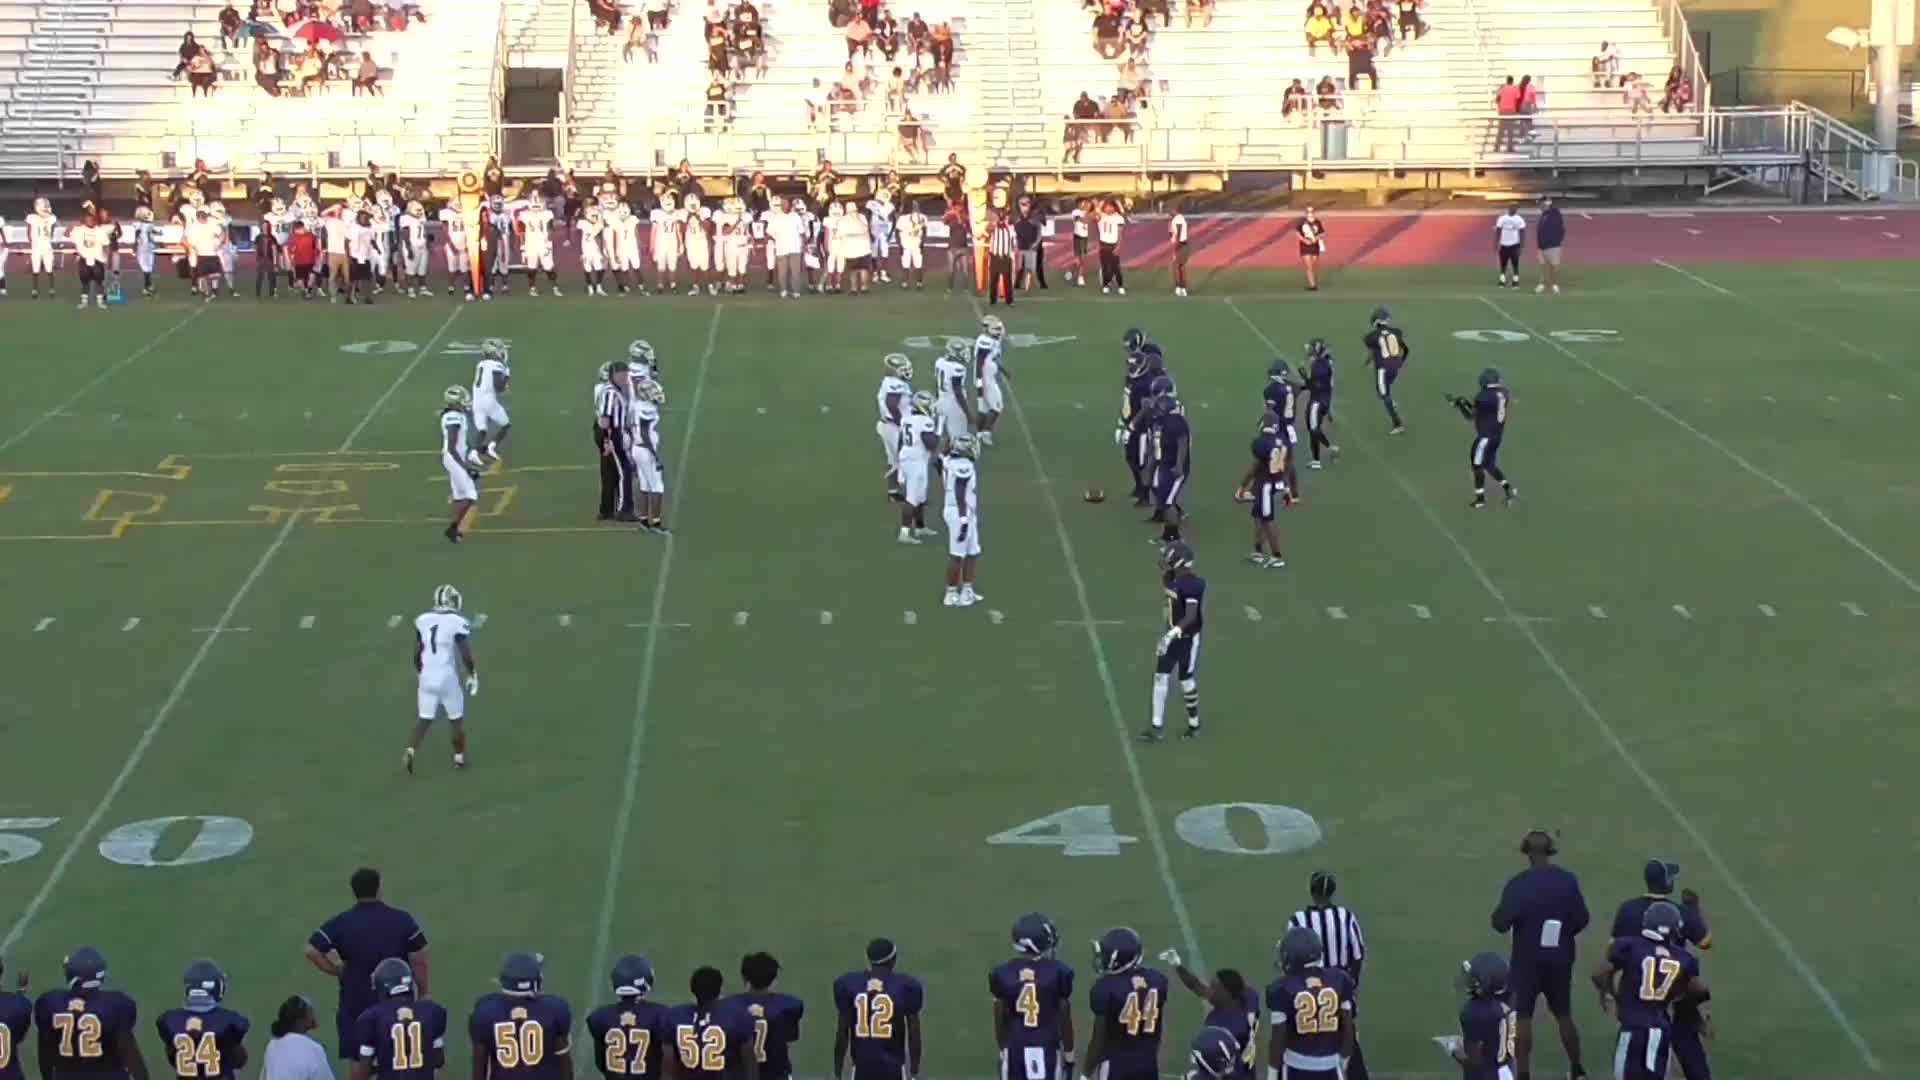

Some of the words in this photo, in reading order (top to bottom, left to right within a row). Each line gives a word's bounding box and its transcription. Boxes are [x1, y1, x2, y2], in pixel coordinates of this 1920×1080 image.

[1379, 333, 1400, 359] 10
[430, 624, 438, 655] 1
[987, 803, 1322, 856] 40
[1639, 956, 1681, 1000] 17
[855, 993, 894, 1039] 12
[1016, 981, 1040, 1028] 4
[1119, 988, 1159, 1036] 44
[1295, 987, 1339, 1035] 22
[53, 1012, 104, 1057] 72
[174, 1031, 221, 1077] 24
[391, 1021, 424, 1070] 11
[494, 1019, 544, 1068] 50
[604, 1027, 650, 1074] 27
[676, 1023, 726, 1071] 52
